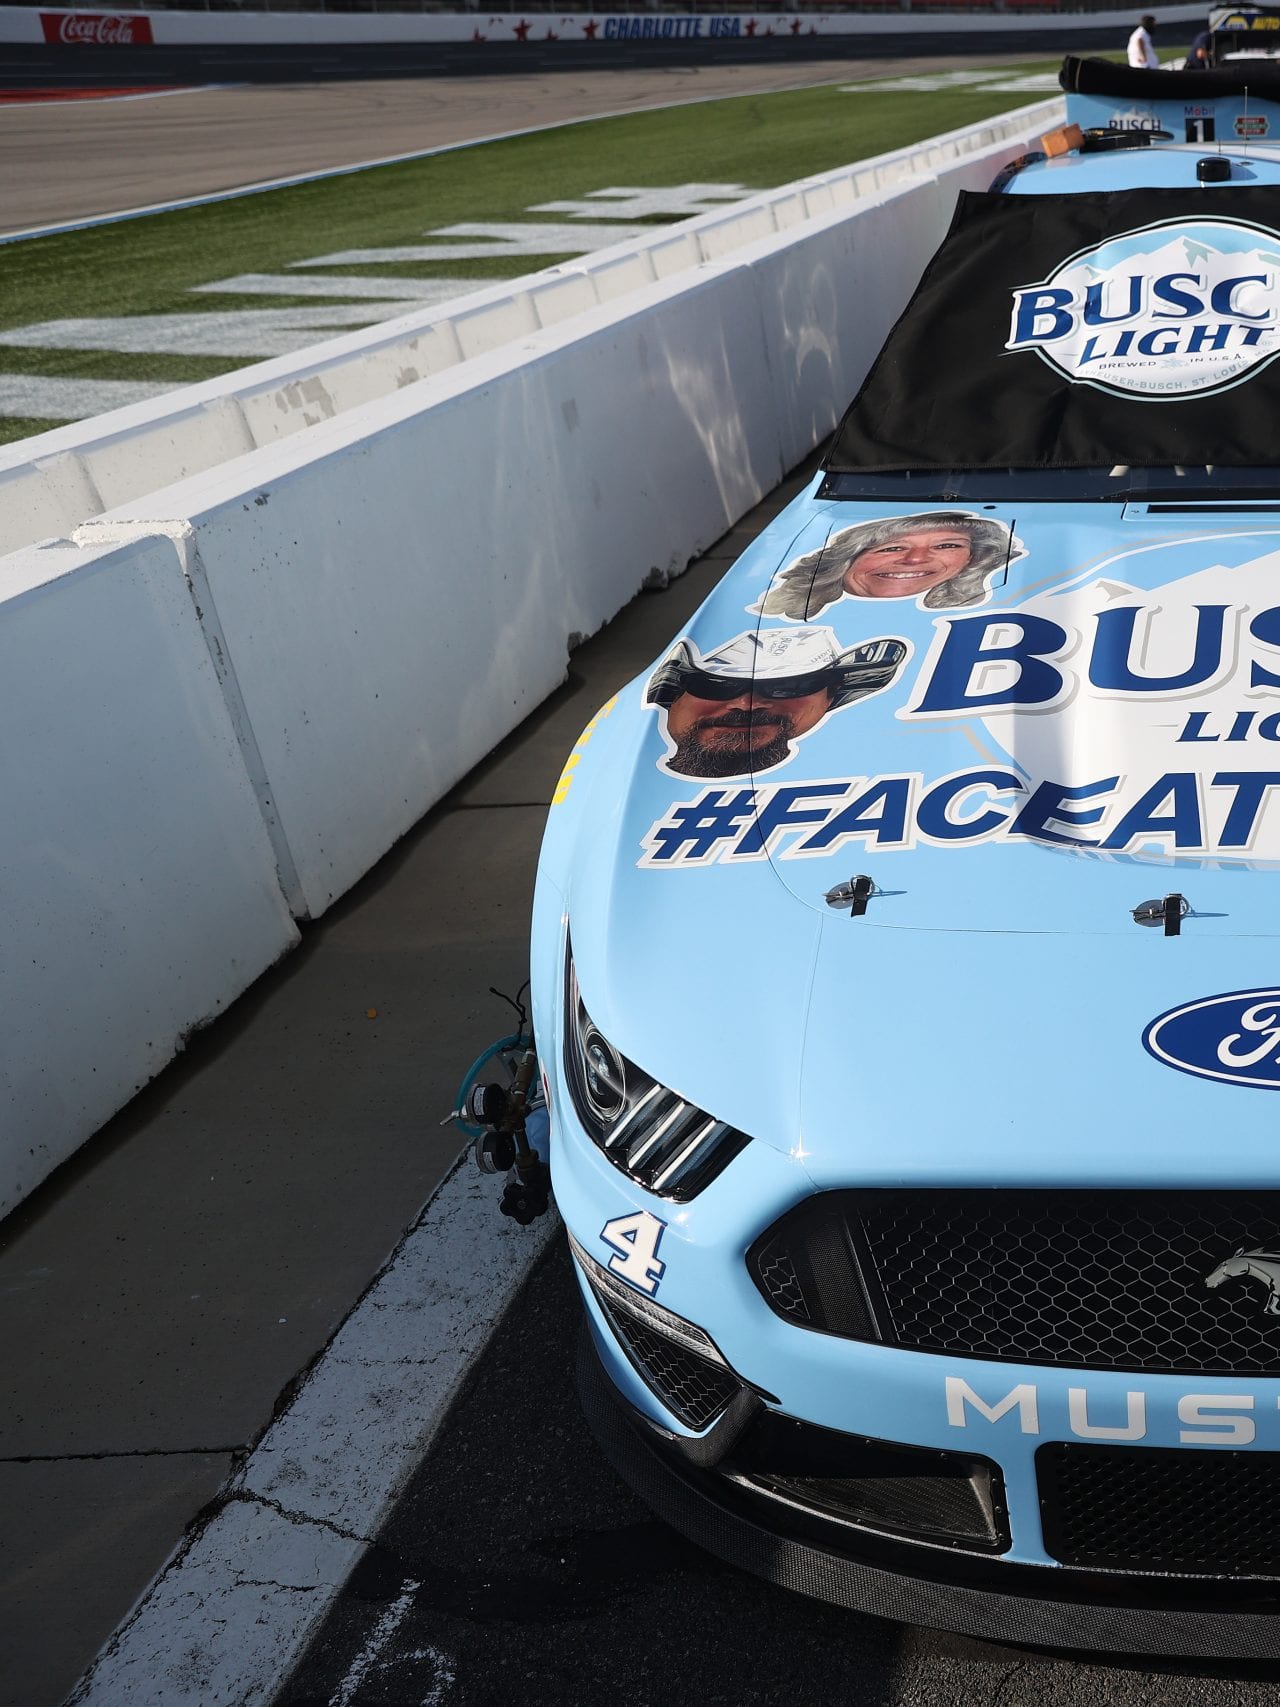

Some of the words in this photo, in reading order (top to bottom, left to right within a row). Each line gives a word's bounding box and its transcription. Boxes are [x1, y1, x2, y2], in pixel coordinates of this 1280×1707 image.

[604, 16, 703, 39] CHARLOTTE
[709, 16, 741, 38] USA
[1184, 105, 1216, 117] Mobil
[1193, 119, 1205, 144] 1
[1076, 323, 1275, 368] LIGHT
[1098, 361, 1158, 370] BREWED
[599, 1210, 669, 1299] 4
